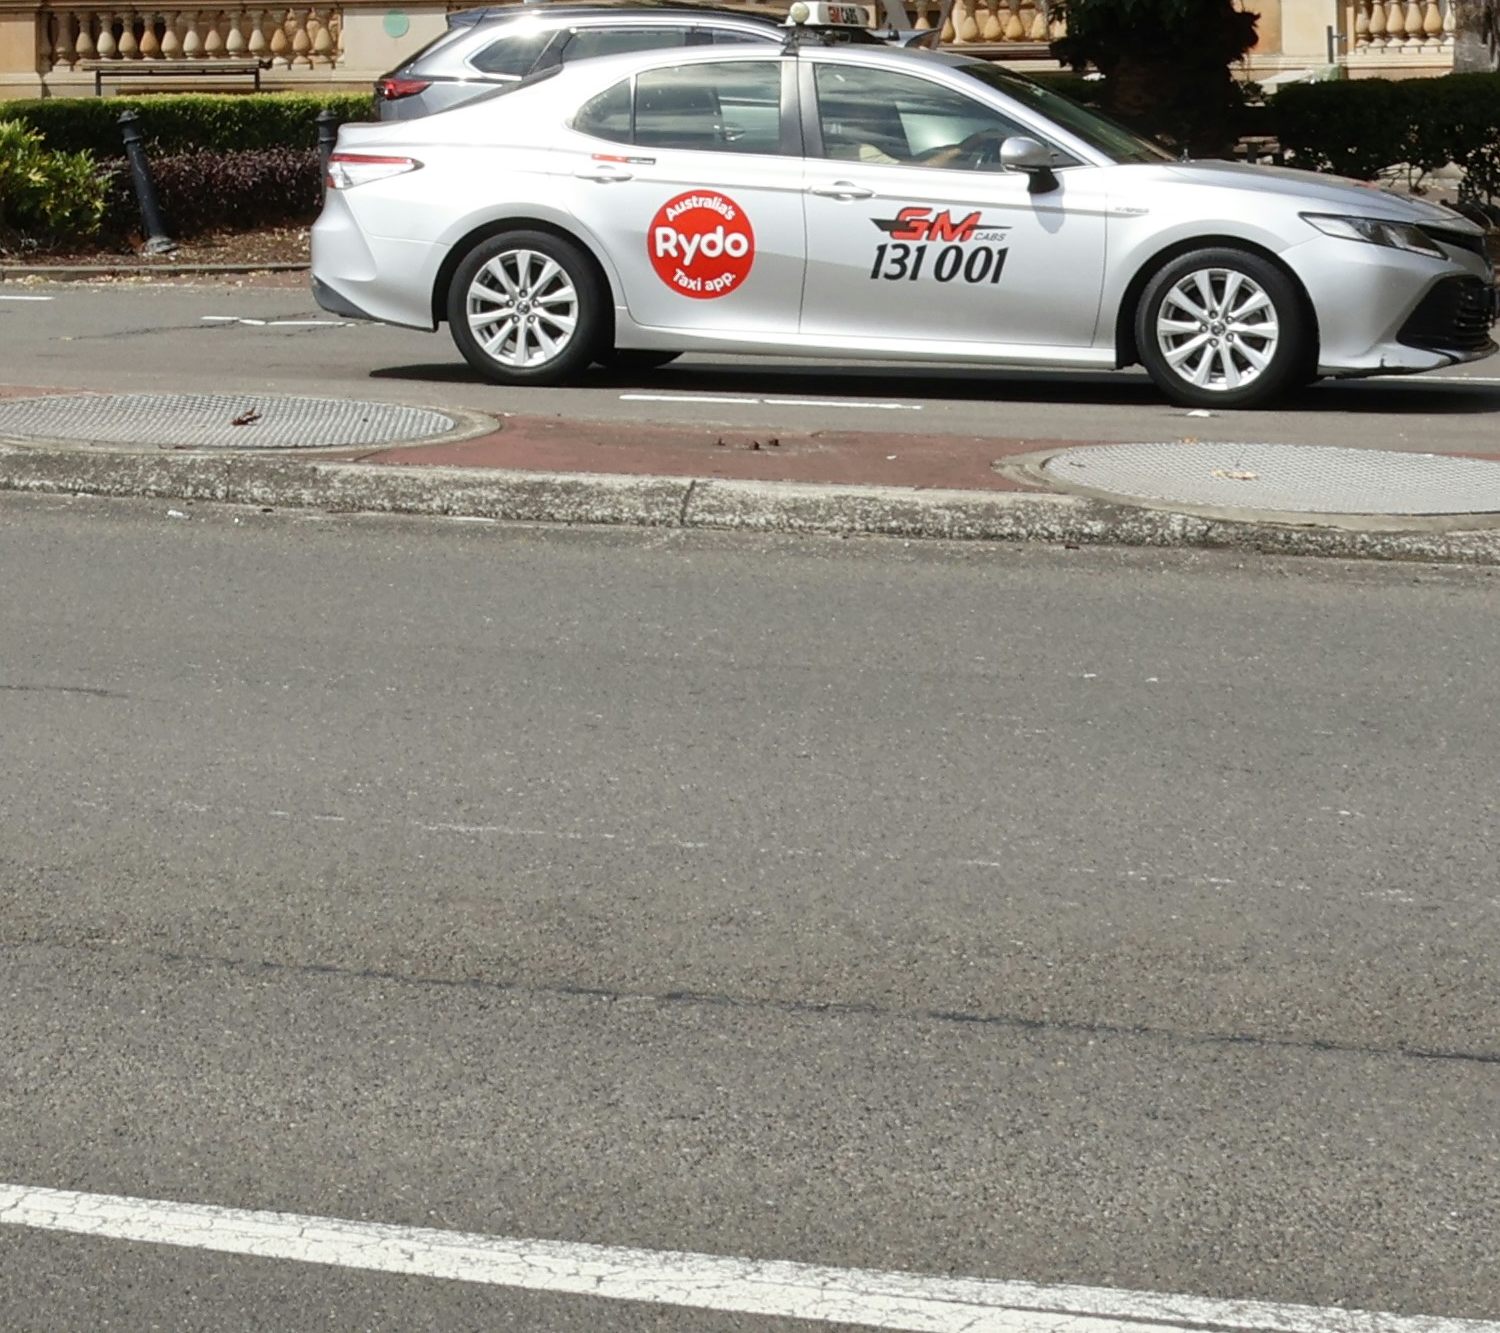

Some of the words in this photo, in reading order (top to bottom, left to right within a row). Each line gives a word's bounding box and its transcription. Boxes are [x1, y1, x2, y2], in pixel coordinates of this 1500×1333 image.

[665, 196, 736, 222] Australia's
[889, 206, 982, 242] GM
[974, 232, 1007, 241] CABS
[655, 225, 749, 266] Rydo
[870, 243, 927, 281] 131
[933, 244, 1009, 284] 001
[673, 268, 702, 291] Taxi
[705, 272, 737, 292] app.
